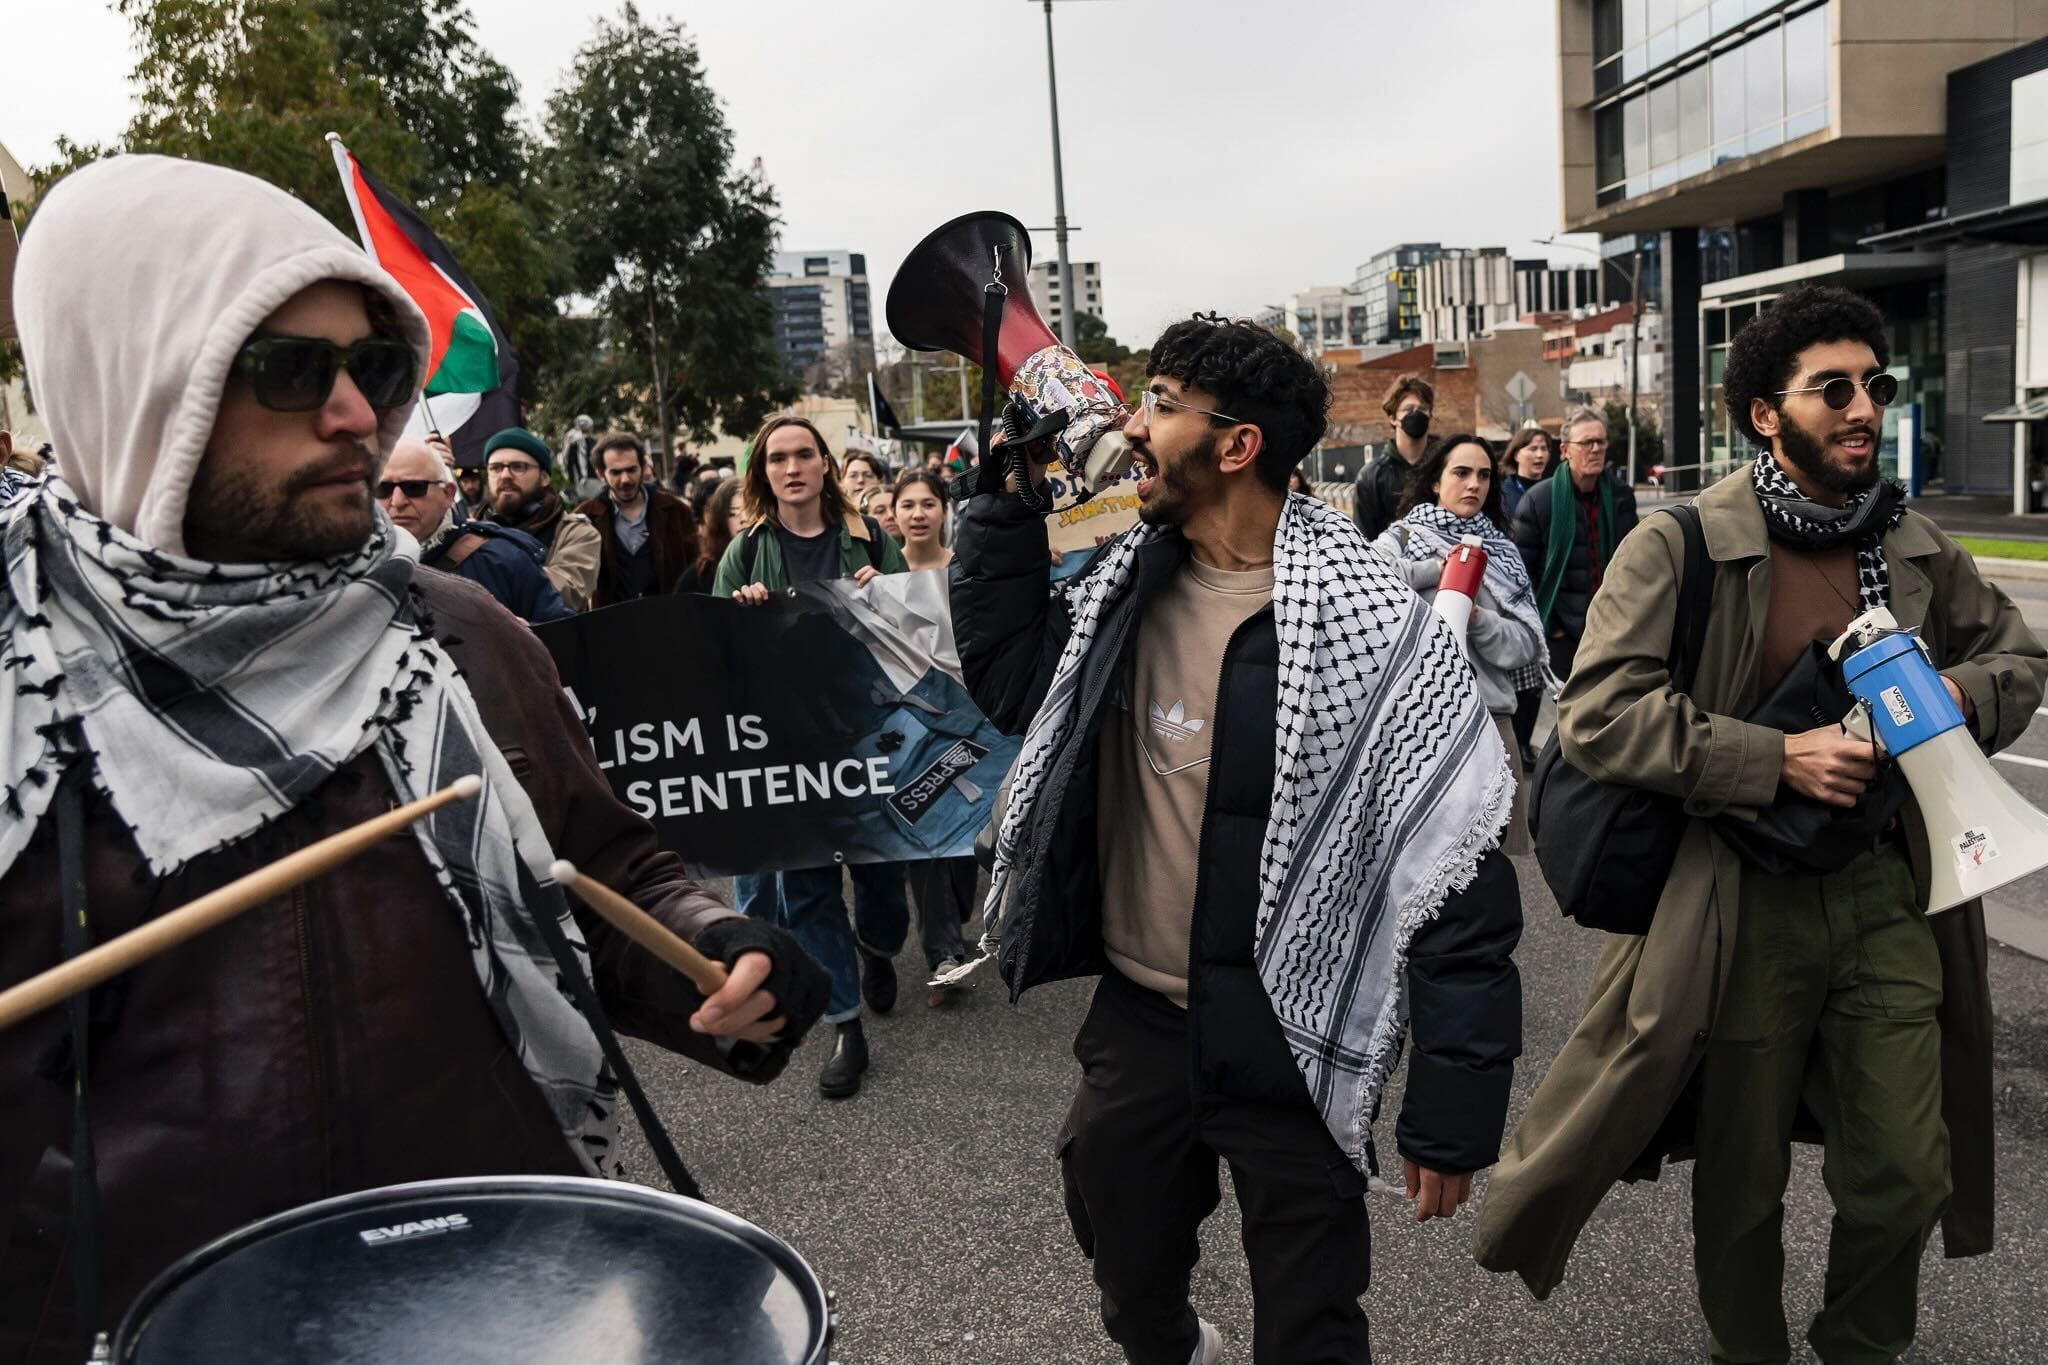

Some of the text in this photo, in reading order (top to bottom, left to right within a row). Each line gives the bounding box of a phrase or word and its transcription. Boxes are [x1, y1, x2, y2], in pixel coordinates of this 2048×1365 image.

[1892, 687, 1914, 721] VONYX
[725, 713, 769, 752] IS
[626, 755, 896, 821] SENTENCE
[900, 763, 956, 811] PRESS
[1959, 833, 1987, 851] PALESTINE
[359, 1213, 470, 1242] EVANS
